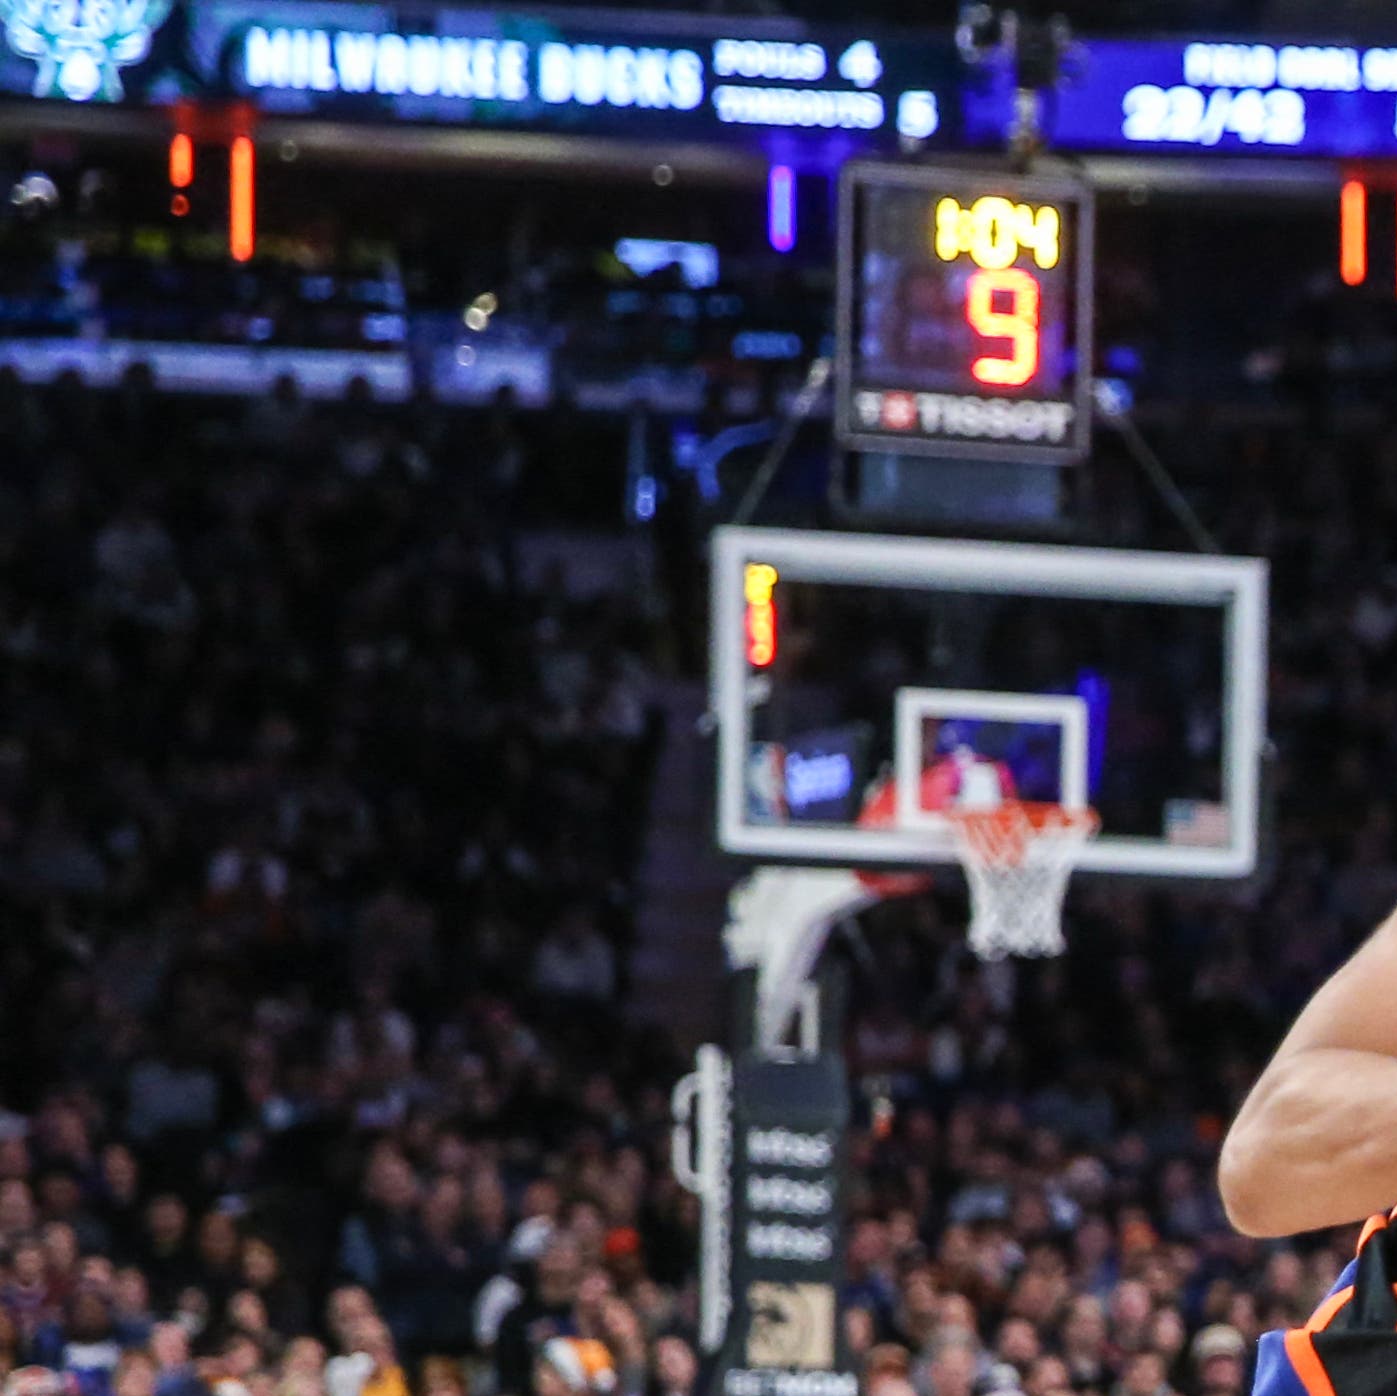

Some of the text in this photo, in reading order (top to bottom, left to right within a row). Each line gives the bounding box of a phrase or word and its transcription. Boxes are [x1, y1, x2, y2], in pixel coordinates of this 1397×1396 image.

[246, 27, 704, 110] MILWAUKEE BUCKS
[967, 268, 1041, 386] 9
[916, 392, 1074, 443] TISSOT
